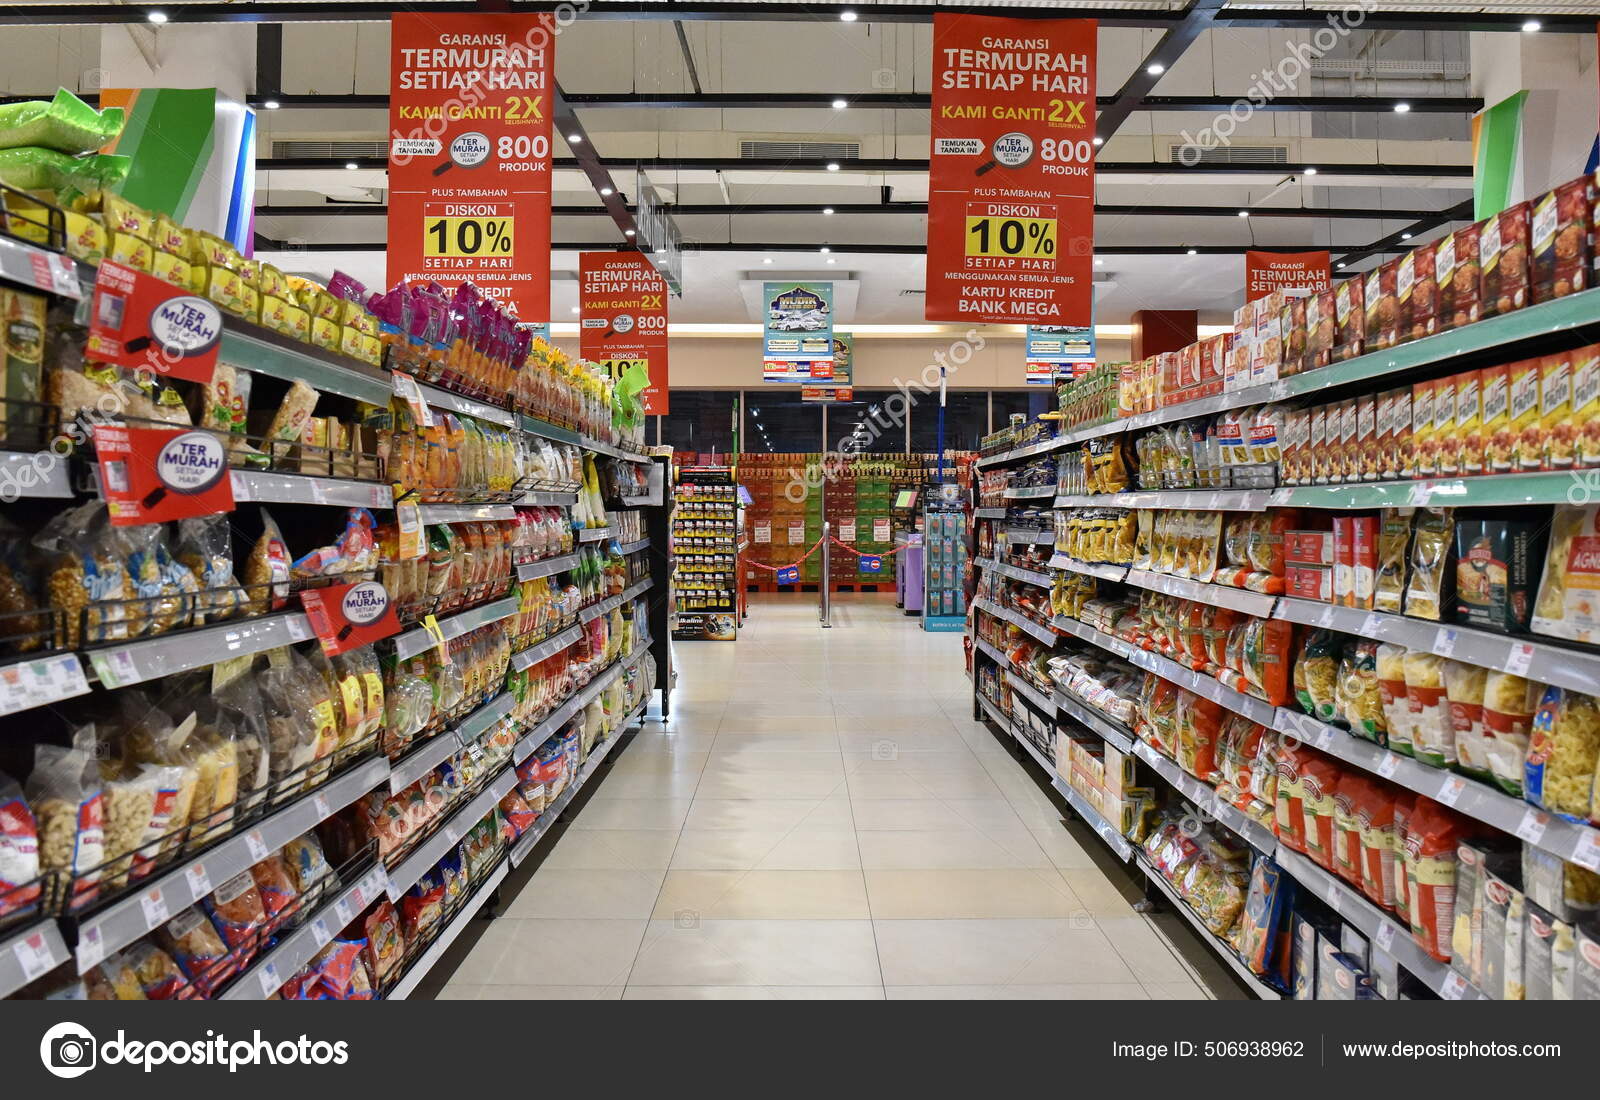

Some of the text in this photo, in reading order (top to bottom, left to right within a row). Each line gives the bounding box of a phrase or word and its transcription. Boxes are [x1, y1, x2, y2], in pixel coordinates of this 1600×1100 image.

[440, 34, 506, 46] GARANSI
[982, 37, 1049, 49] GARANSI
[401, 48, 545, 69] TERMURAH
[944, 49, 1087, 73] TERMURAH
[400, 70, 545, 89] SETIAP HARI
[942, 71, 1088, 94] SETIAP HARI
[400, 96, 542, 119] KAMI GANTI 2X
[941, 100, 1086, 124] KAMI GANTI 2X
[498, 136, 548, 159] 800
[996, 145, 1029, 153] MURAH
[1041, 139, 1091, 163] 800
[500, 163, 545, 171] PRODUK
[1042, 165, 1088, 176] PRODUK
[432, 189, 507, 197] PLUS TAMBAHAN
[974, 188, 1051, 199] PLUS TAMBAHAN
[446, 204, 496, 216] DISKON
[988, 205, 1039, 217] DISKON
[429, 219, 511, 254] 10%
[971, 219, 1054, 255] 10%
[425, 258, 512, 268] SETIAP HARI
[966, 258, 1055, 270] SETIAP HARI
[585, 271, 662, 282] TERMURAH
[945, 272, 1074, 284] MENGGUNAKAN SEMUA JENIS
[1252, 269, 1326, 280] TERMURAH
[478, 287, 512, 297] REDIT
[585, 282, 662, 293] SETIAP HARI
[1251, 281, 1327, 291] SETIAP HARI
[962, 286, 1055, 299] KARTU KREDIT
[611, 301, 639, 309] GANTI
[641, 295, 662, 308] 2X
[959, 300, 1006, 314] BANK
[181, 304, 206, 324] TER
[161, 308, 214, 340] MURAH
[638, 316, 665, 329] 800
[605, 361, 644, 381] 10
[180, 443, 208, 456] TER
[164, 455, 219, 468] MURAH
[356, 590, 375, 598] TER
[346, 597, 385, 608] MURAH
